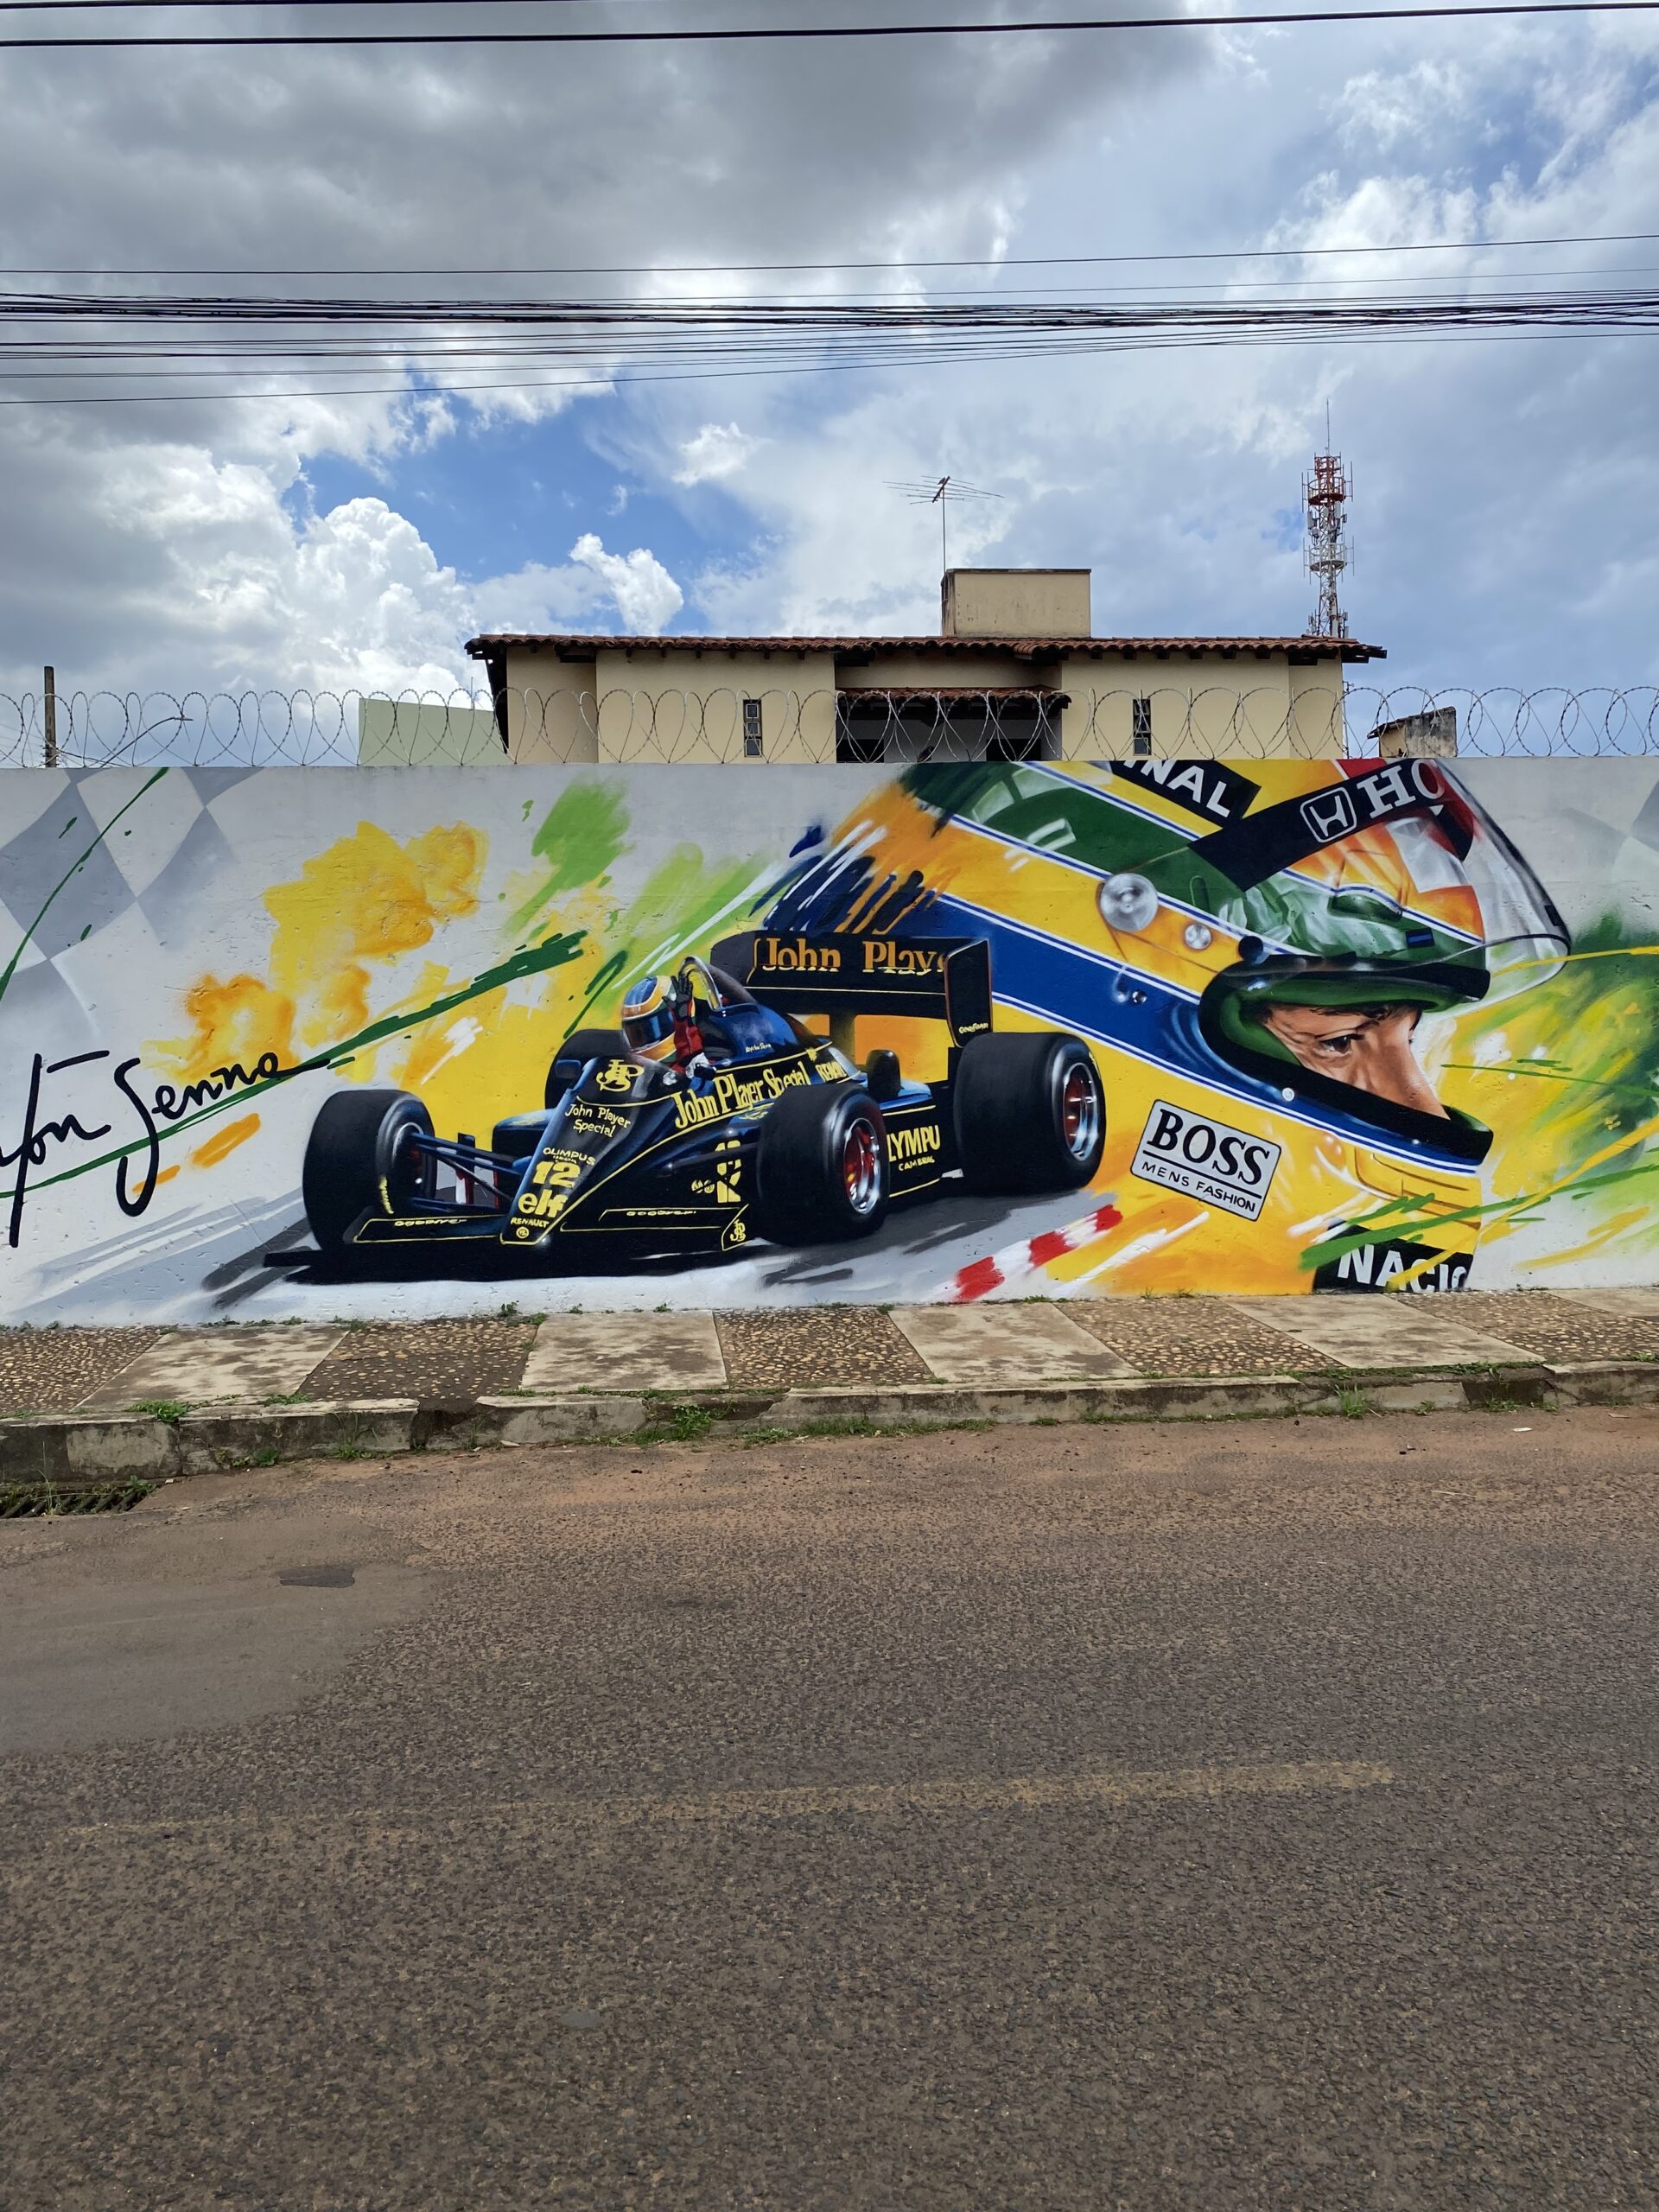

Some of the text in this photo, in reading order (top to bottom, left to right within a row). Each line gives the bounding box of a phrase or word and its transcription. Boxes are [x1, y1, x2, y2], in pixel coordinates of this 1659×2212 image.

[1122, 760, 1230, 818] NAL
[1356, 758, 1446, 819] HO
[761, 938, 841, 973] John
[564, 1103, 632, 1128] John Player
[675, 1088, 719, 1129] John
[572, 1118, 617, 1138] Special
[1147, 1108, 1270, 1185] BOSS
[532, 1160, 581, 1189] 12
[1141, 1160, 1256, 1212] MENS FASHION
[518, 1188, 569, 1218] elf
[510, 1217, 550, 1229] RENAULT
